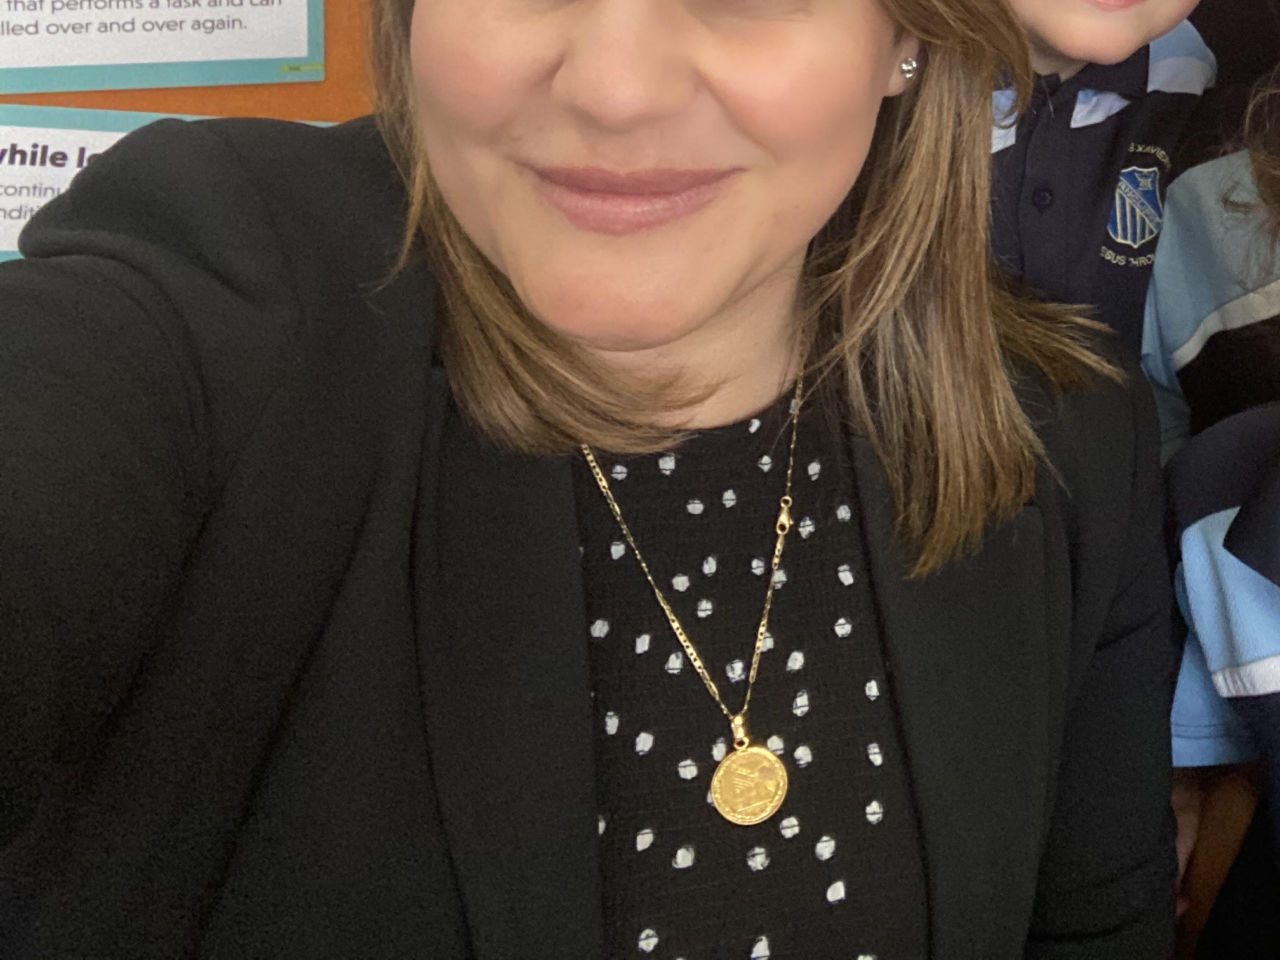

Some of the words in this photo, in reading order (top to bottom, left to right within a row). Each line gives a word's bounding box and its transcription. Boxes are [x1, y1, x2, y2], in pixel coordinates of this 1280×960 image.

[45, 22, 92, 35] over
[98, 17, 136, 33] and
[142, 19, 185, 32] over
[191, 16, 248, 35] again.
